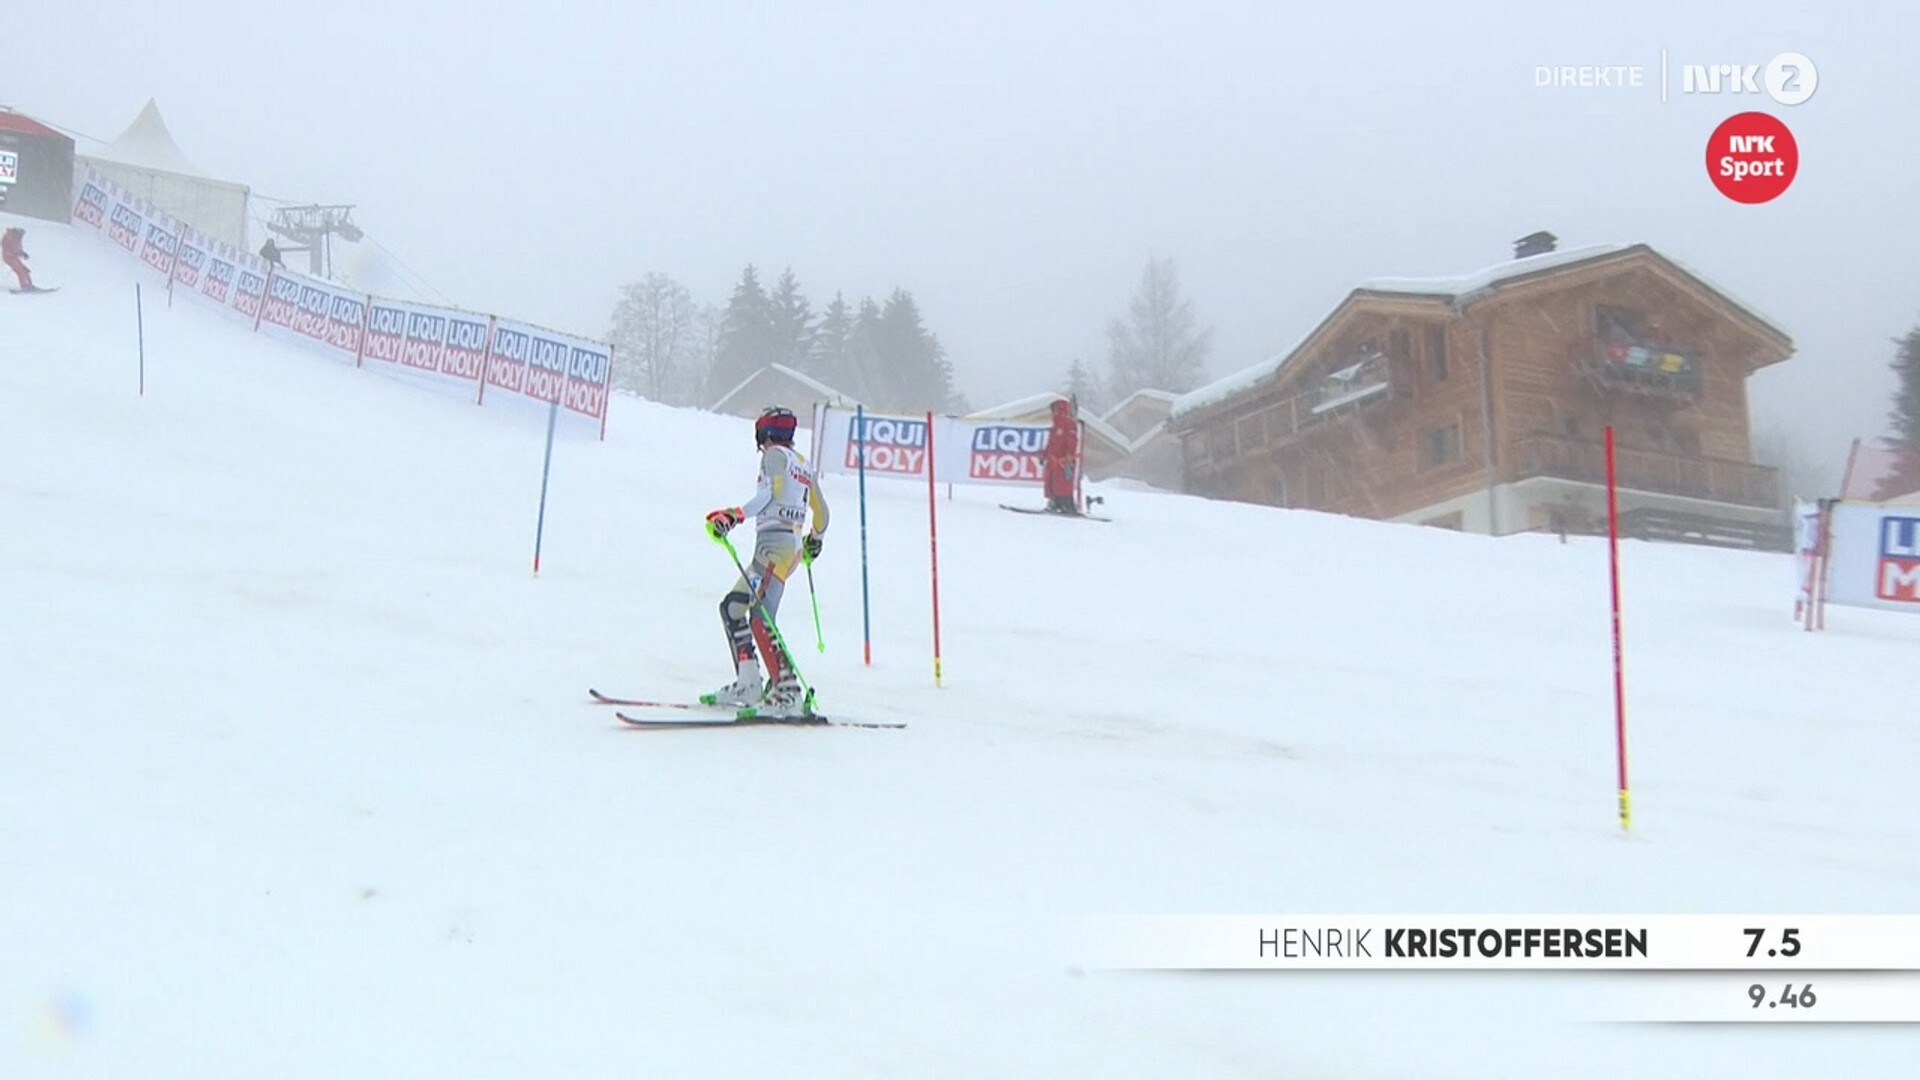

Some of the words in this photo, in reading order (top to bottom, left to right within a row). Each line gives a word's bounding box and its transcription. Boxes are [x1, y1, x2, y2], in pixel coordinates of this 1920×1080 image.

[371, 308, 404, 334] LIQUI
[409, 315, 443, 341] LIQUI
[366, 333, 400, 360] MOLY
[449, 321, 485, 350] LIQUI
[494, 330, 527, 361] LIQUI
[404, 342, 440, 368] MOLY
[443, 349, 482, 376] MOLY
[531, 340, 566, 371] LIQUI
[571, 350, 606, 383] LIQUI
[489, 358, 524, 388] MOLY
[527, 369, 562, 400] MOLY
[567, 380, 603, 414] MOLY
[853, 420, 924, 446] LIQUI
[976, 429, 1050, 452] LIQUI
[849, 444, 922, 471] MOLY
[973, 455, 1047, 479] MOLY
